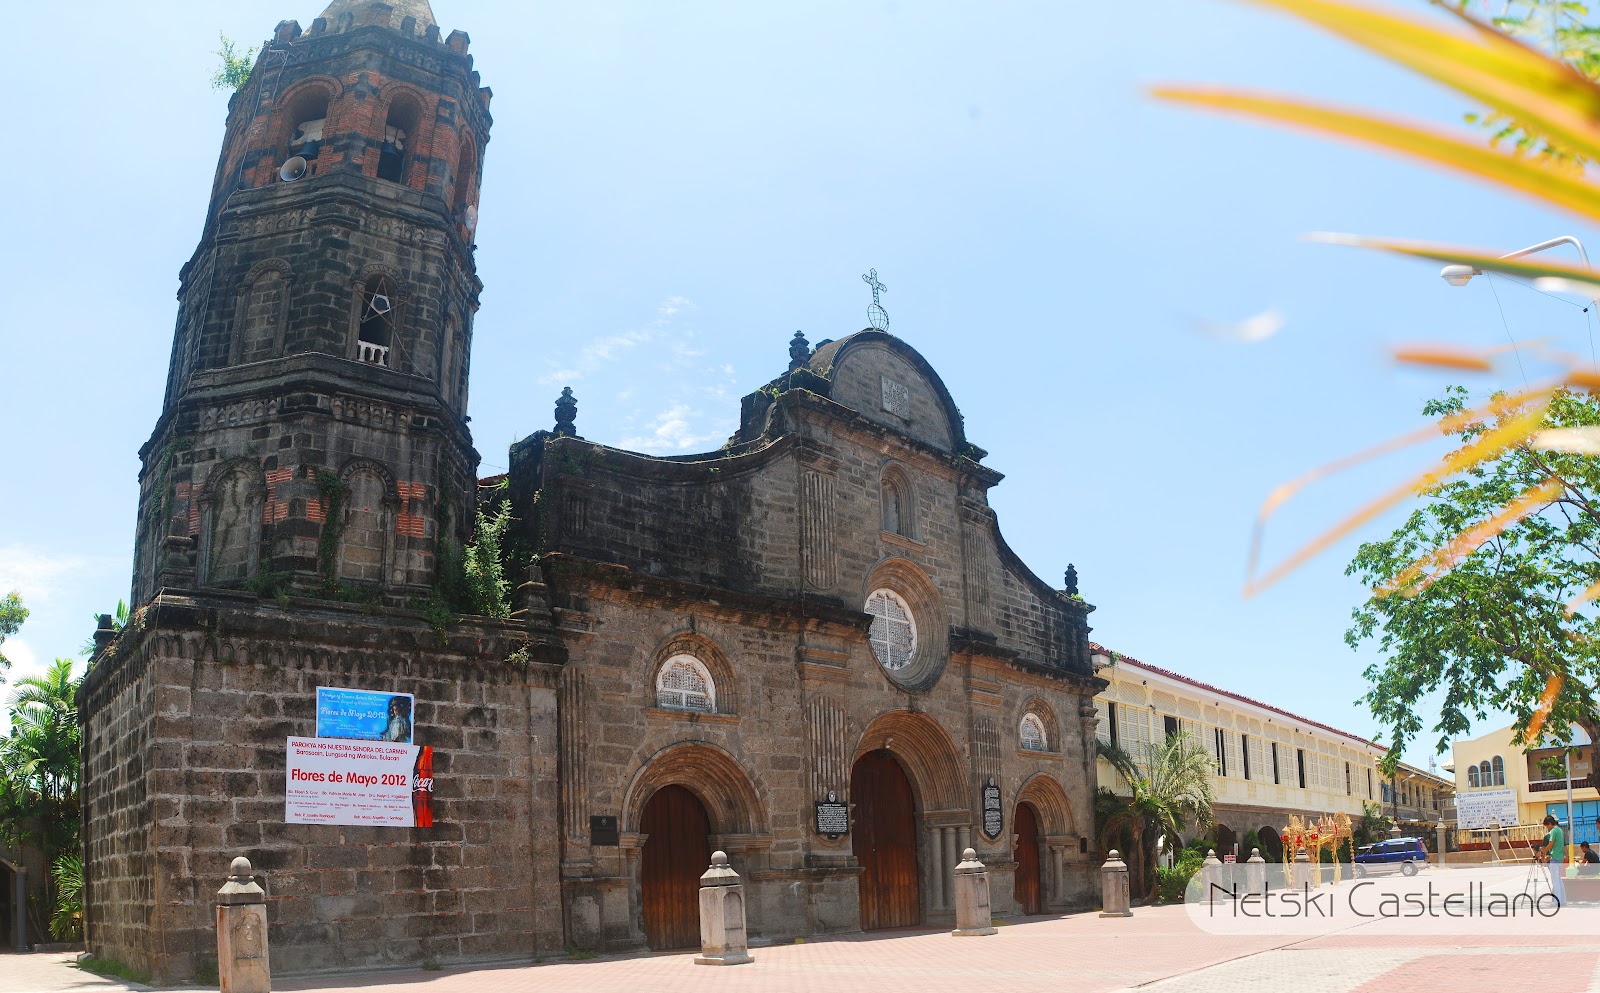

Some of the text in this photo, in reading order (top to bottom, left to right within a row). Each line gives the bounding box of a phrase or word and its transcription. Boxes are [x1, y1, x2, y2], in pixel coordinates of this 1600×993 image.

[348, 708, 366, 720] Mayo
[367, 711, 386, 719] 2012
[292, 768, 406, 787] Flores de Mayo 2012
